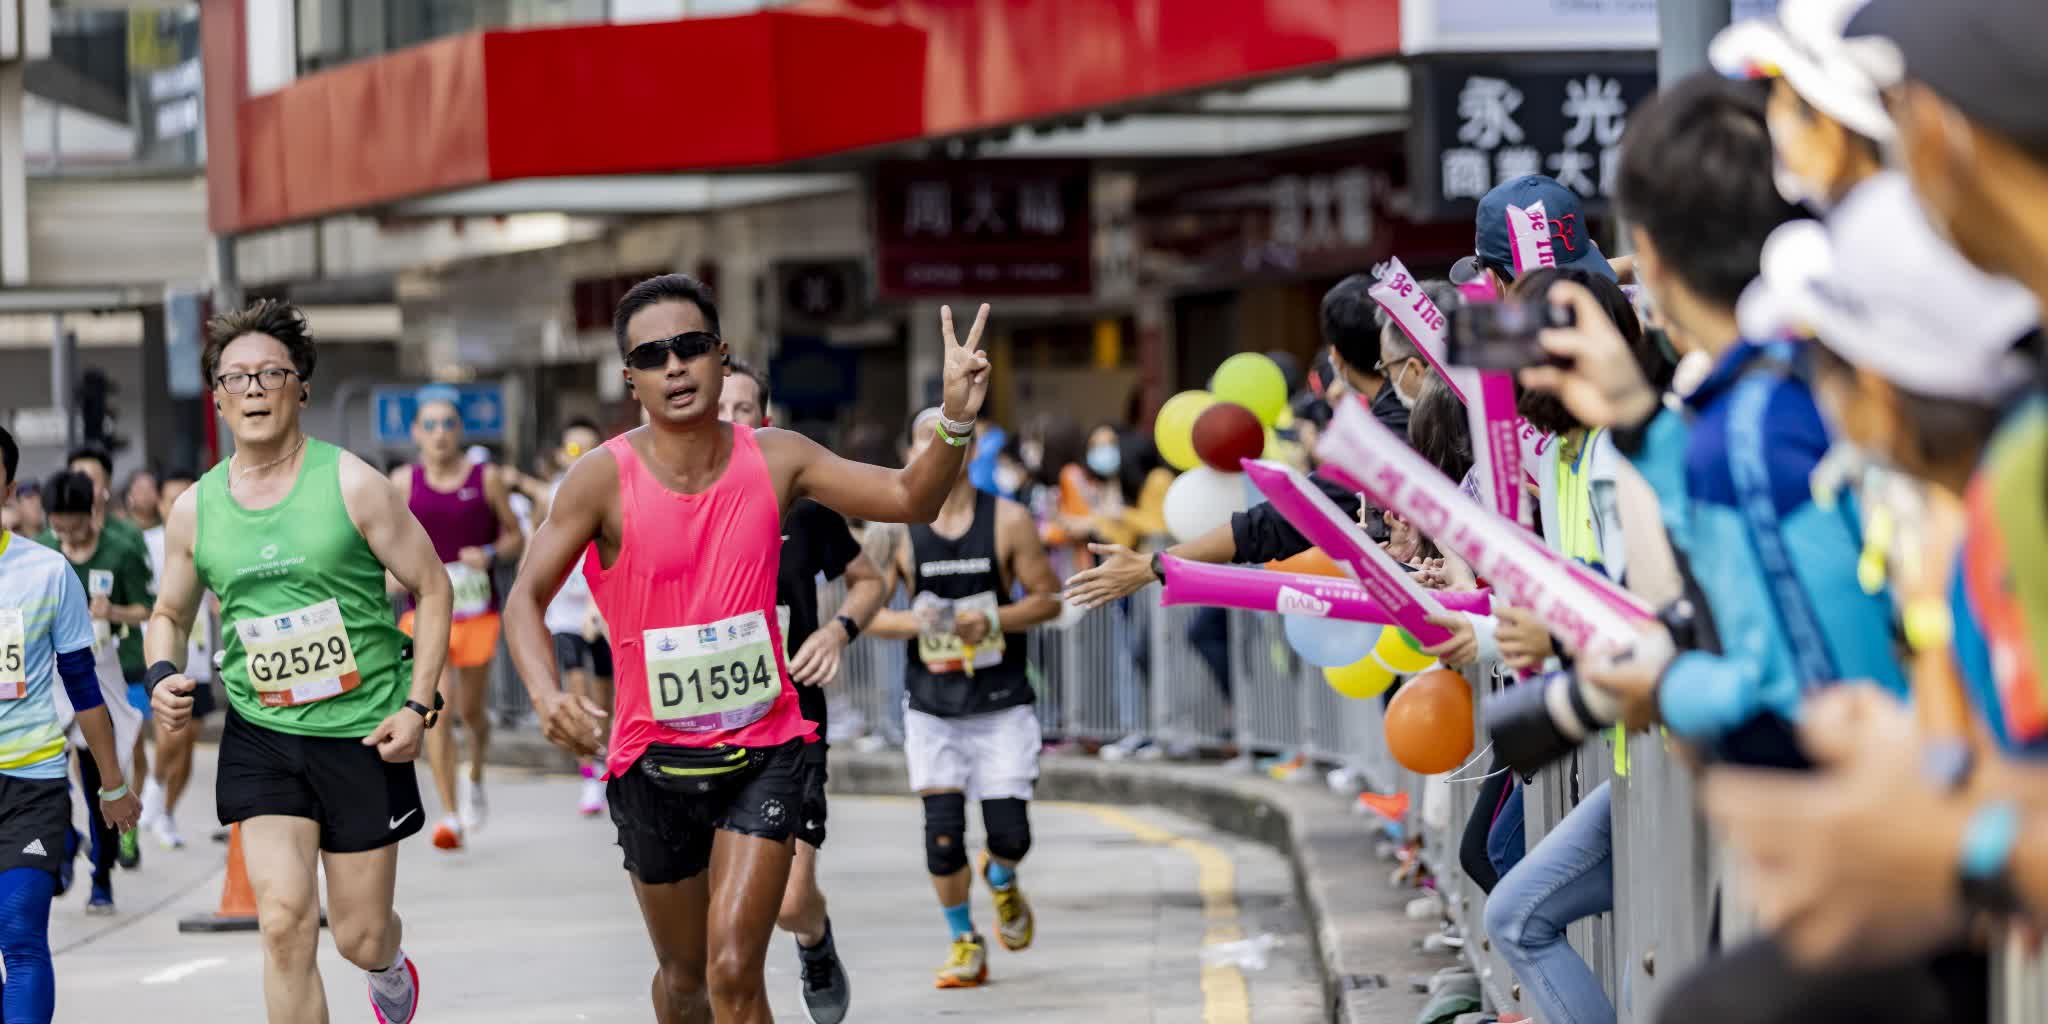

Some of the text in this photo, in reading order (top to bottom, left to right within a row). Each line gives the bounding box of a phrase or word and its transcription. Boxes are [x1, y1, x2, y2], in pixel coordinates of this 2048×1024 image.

[1457, 73, 1627, 149] 永光
[1527, 210, 1555, 268] Be Th
[1389, 272, 1445, 332] Be The
[0, 644, 20, 672] 5
[252, 636, 346, 681] G2529
[659, 654, 771, 707] D1594
